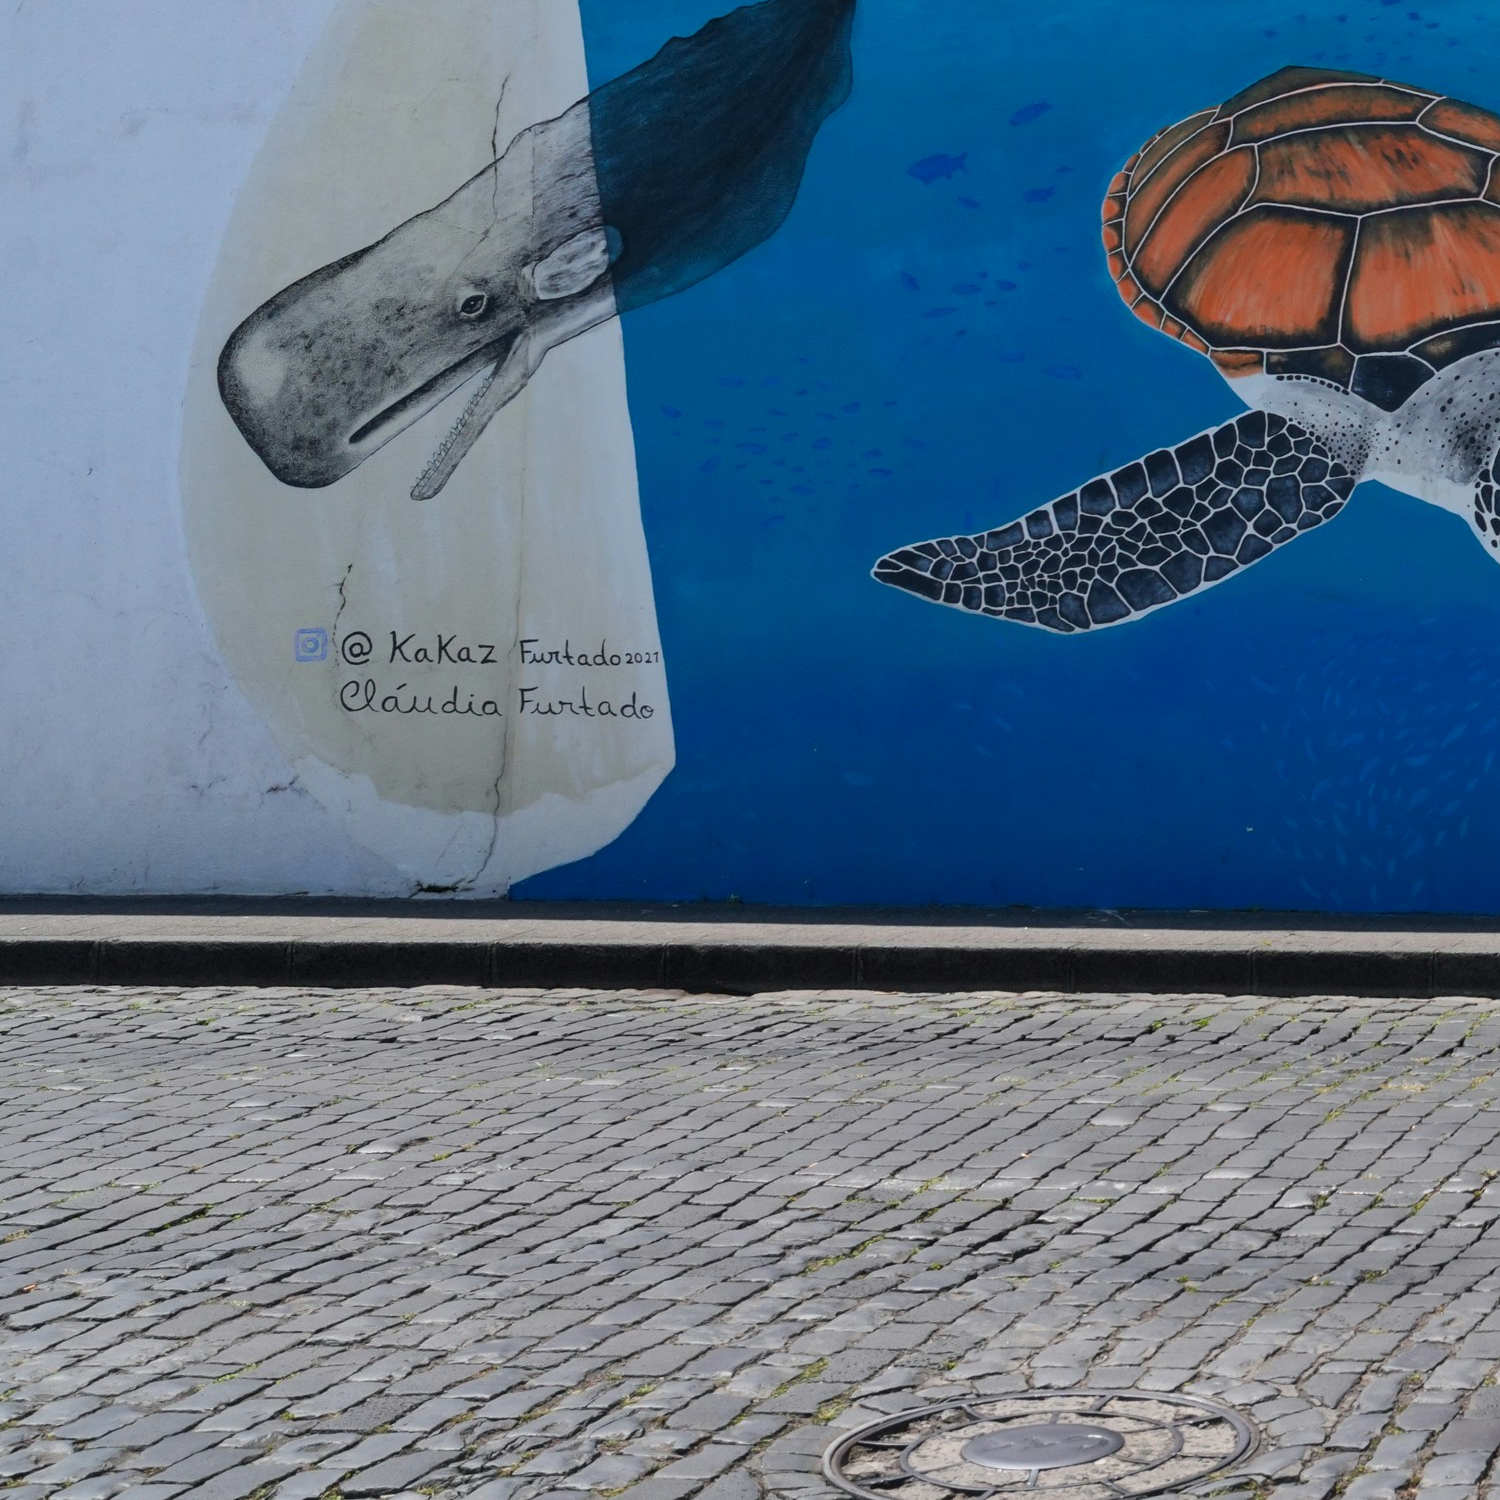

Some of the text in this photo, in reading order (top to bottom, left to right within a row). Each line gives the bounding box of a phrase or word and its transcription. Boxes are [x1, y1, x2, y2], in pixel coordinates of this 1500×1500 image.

[519, 639, 622, 667] Furtado
[625, 650, 660, 666] 2021
[339, 678, 655, 720] Cláudia Furtado
